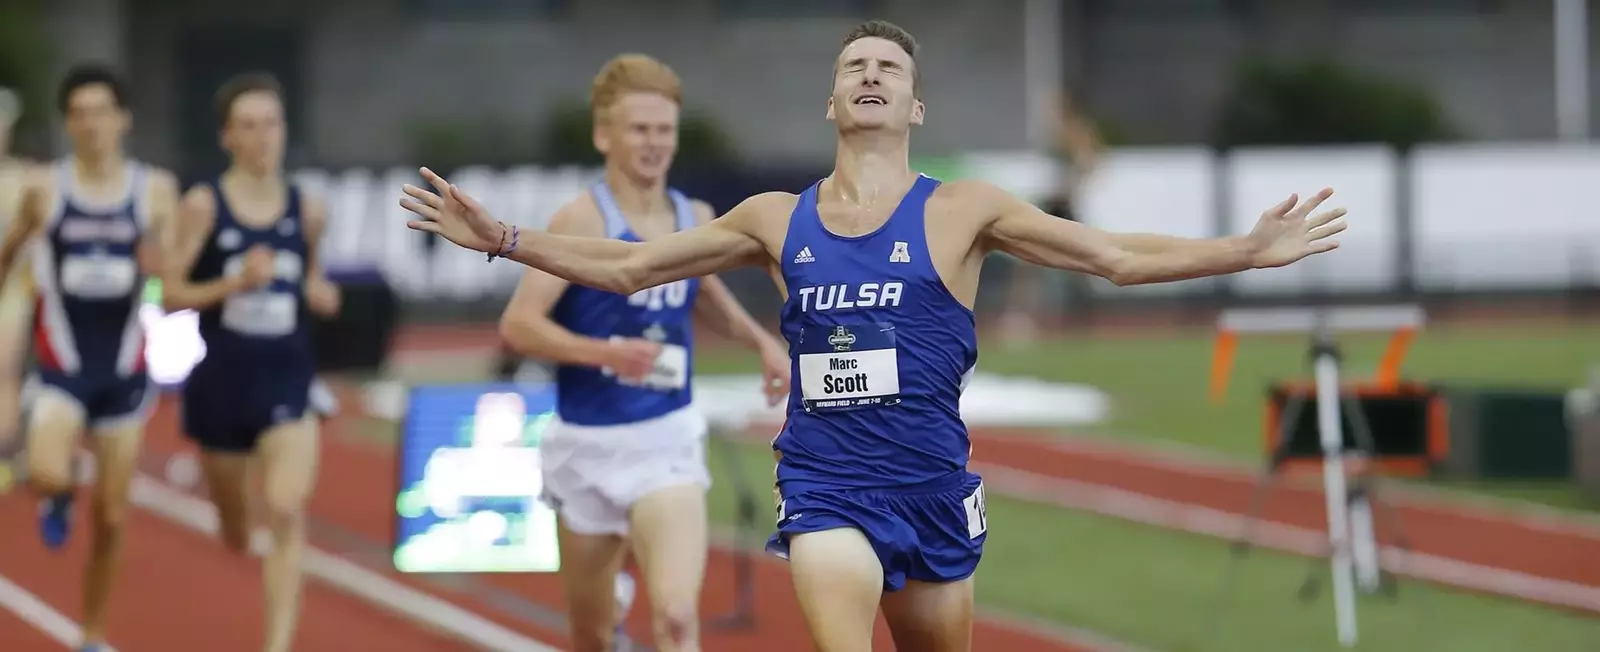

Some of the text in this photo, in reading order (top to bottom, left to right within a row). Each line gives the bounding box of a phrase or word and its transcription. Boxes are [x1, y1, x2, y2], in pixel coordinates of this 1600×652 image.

[794, 256, 815, 264] adidas
[799, 282, 903, 312] TULSA
[829, 358, 858, 370] Marc
[823, 373, 869, 394] Scott
